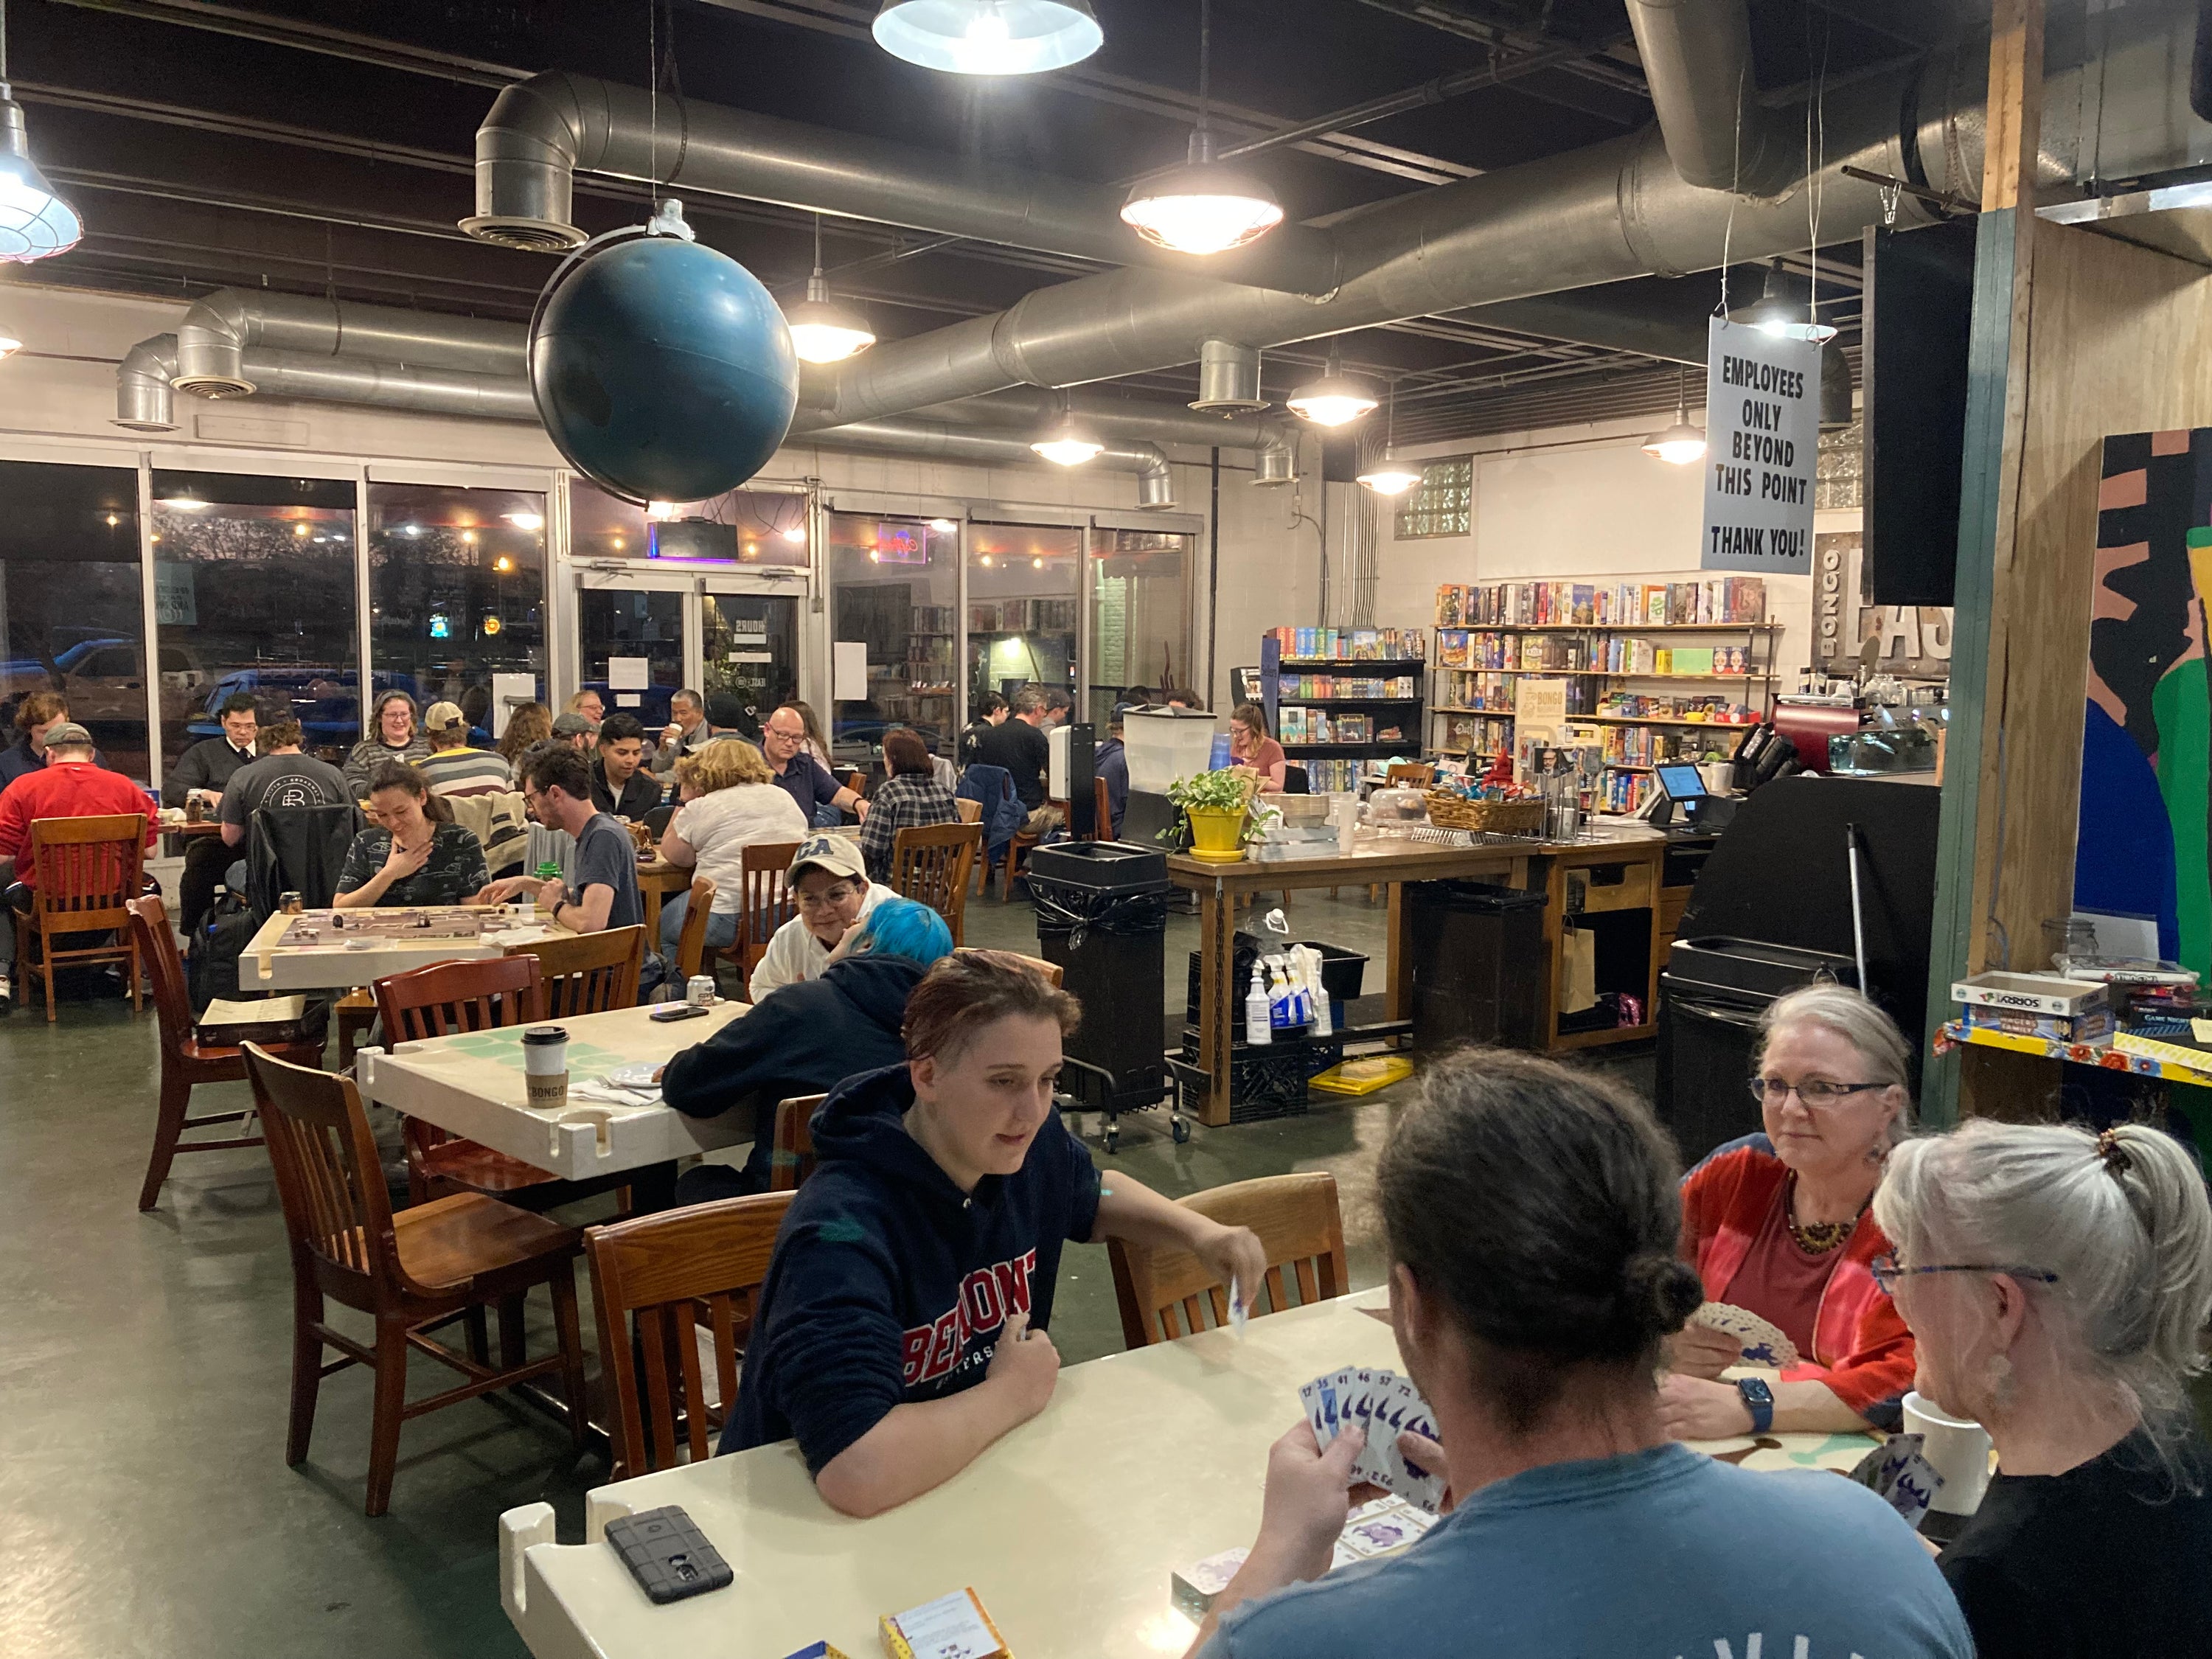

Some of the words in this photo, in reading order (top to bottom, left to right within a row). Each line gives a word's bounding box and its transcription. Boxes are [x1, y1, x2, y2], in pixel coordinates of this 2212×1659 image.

[1722, 355, 1804, 399] EMPLOYEES
[1742, 399, 1781, 431] ONLY
[1733, 431, 1794, 467] BEYOND
[1716, 464, 1752, 495] THIS
[1762, 472, 1807, 504] POINT
[1711, 526, 1764, 555] THANK
[1770, 529, 1804, 557] YOU!
[1820, 549, 1840, 656] BONGO
[1537, 692, 1562, 705] BONGO
[532, 1085, 564, 1098] BONGO
[902, 1247, 1036, 1388] BEON
[1338, 1374, 1348, 1385] 41
